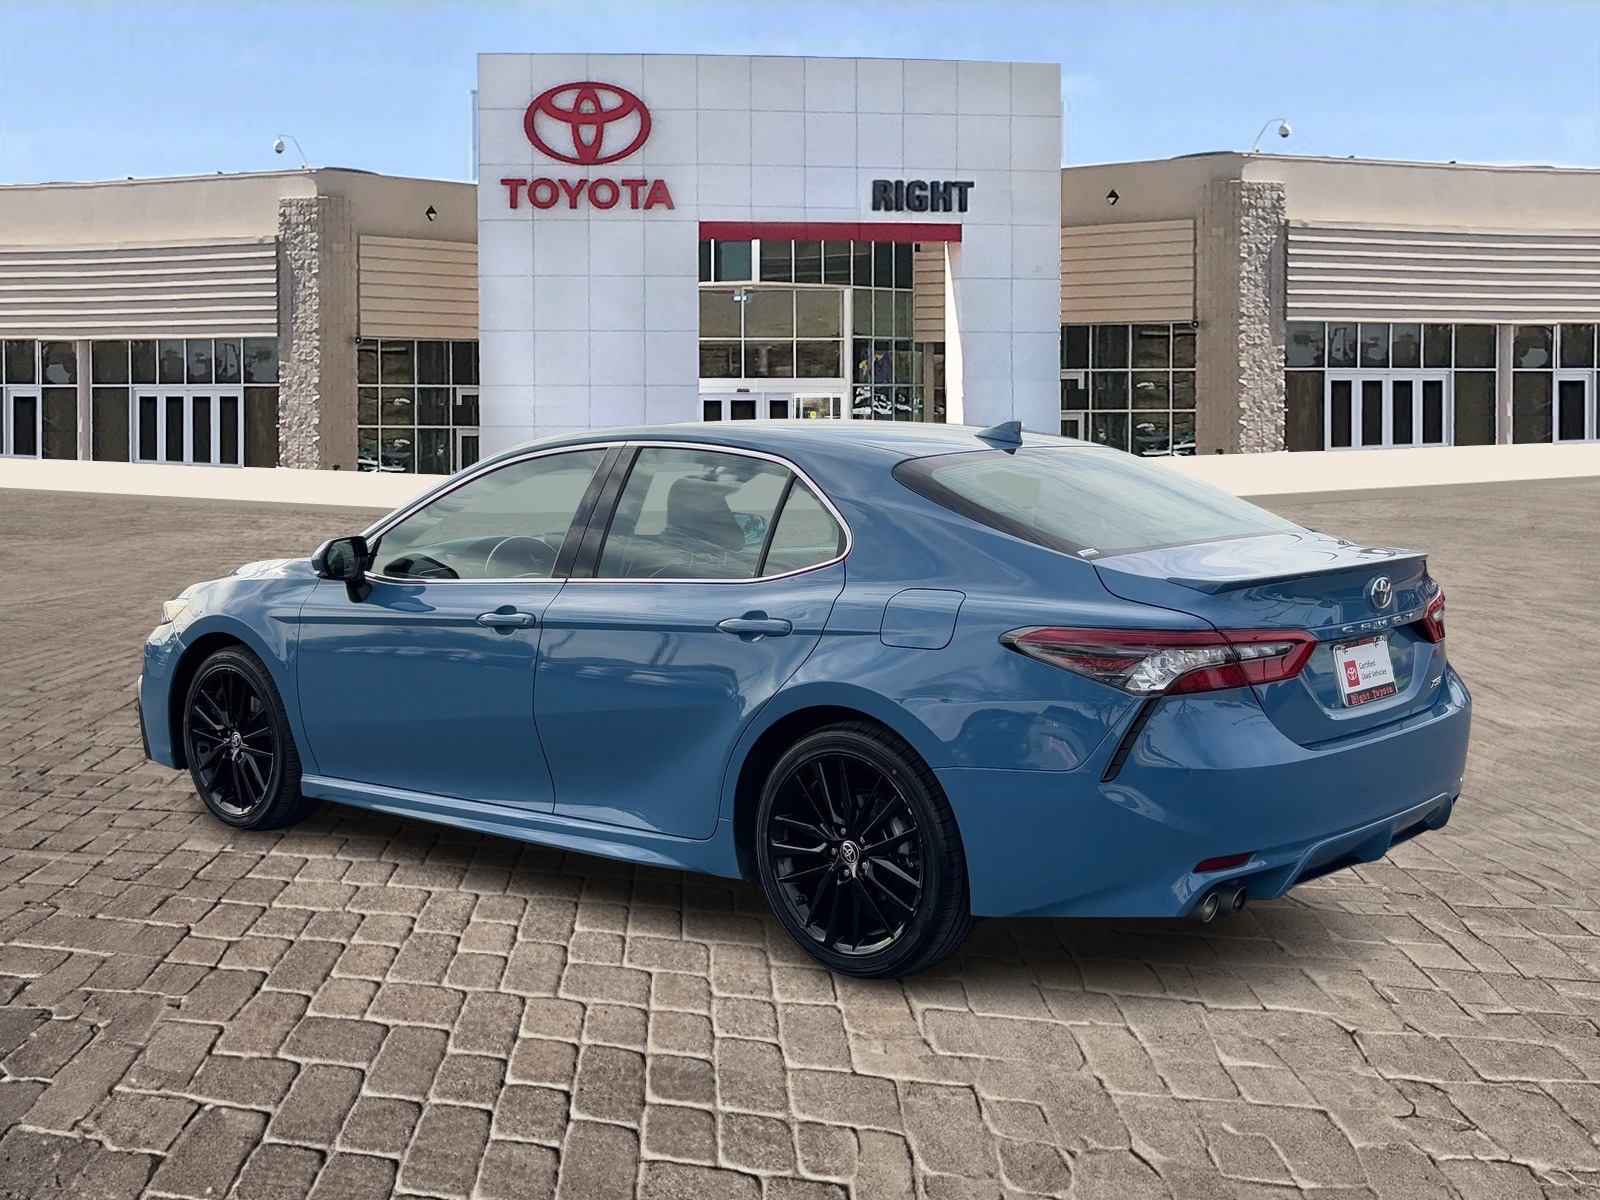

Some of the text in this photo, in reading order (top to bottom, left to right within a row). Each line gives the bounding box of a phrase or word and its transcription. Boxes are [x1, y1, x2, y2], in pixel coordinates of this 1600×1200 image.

[500, 177, 676, 210] TOYOTA
[872, 179, 975, 212] RIGHT
[1342, 612, 1414, 633] CAMRY
[1358, 659, 1376, 670] Certified
[1361, 668, 1387, 680] Used Vehicles
[1350, 686, 1394, 704] Right Toyota
